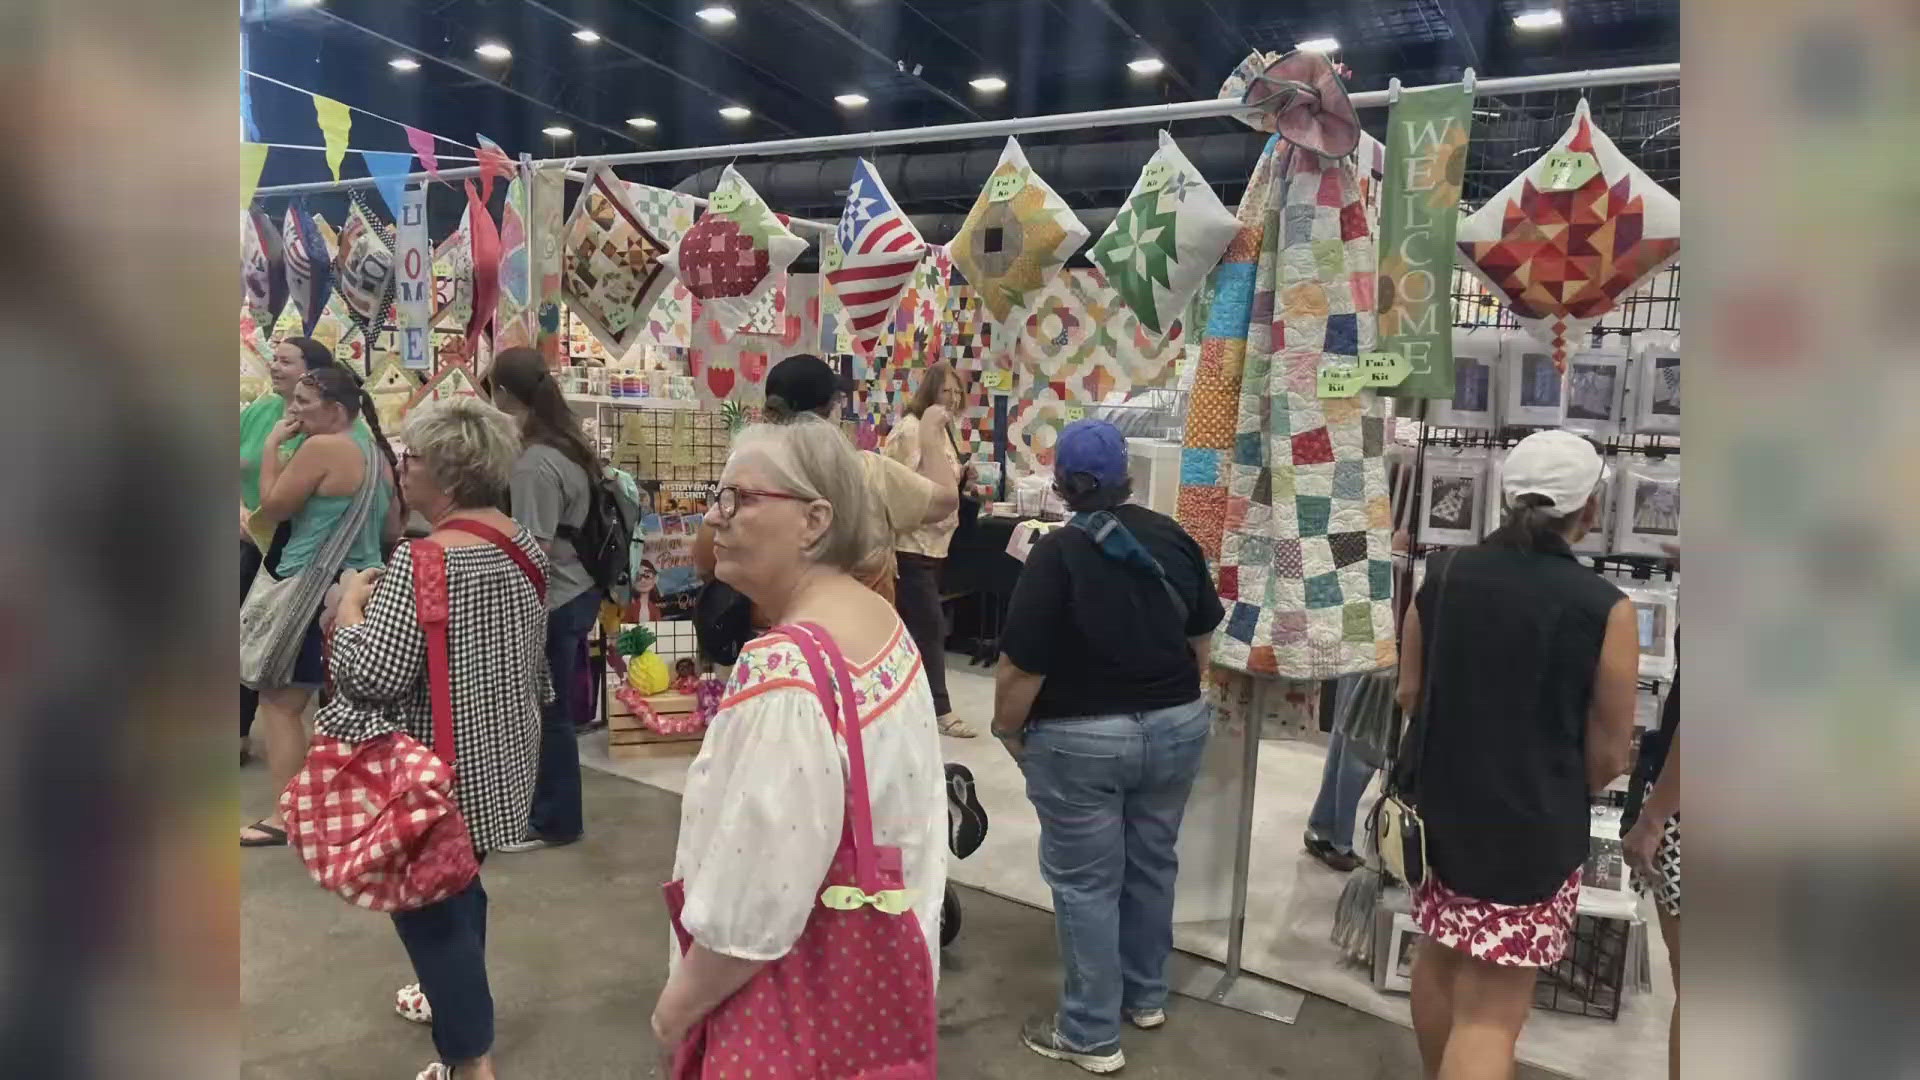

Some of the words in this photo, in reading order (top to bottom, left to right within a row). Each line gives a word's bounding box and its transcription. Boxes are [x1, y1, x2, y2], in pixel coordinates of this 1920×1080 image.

[1394, 116, 1455, 375] WELCOME
[1365, 358, 1384, 367] I'm
[1386, 358, 1396, 367] A
[1371, 372, 1389, 381] Kit
[1329, 383, 1345, 392] Kit
[659, 483, 693, 491] MYSTERY
[671, 491, 707, 499] PRESENTS
